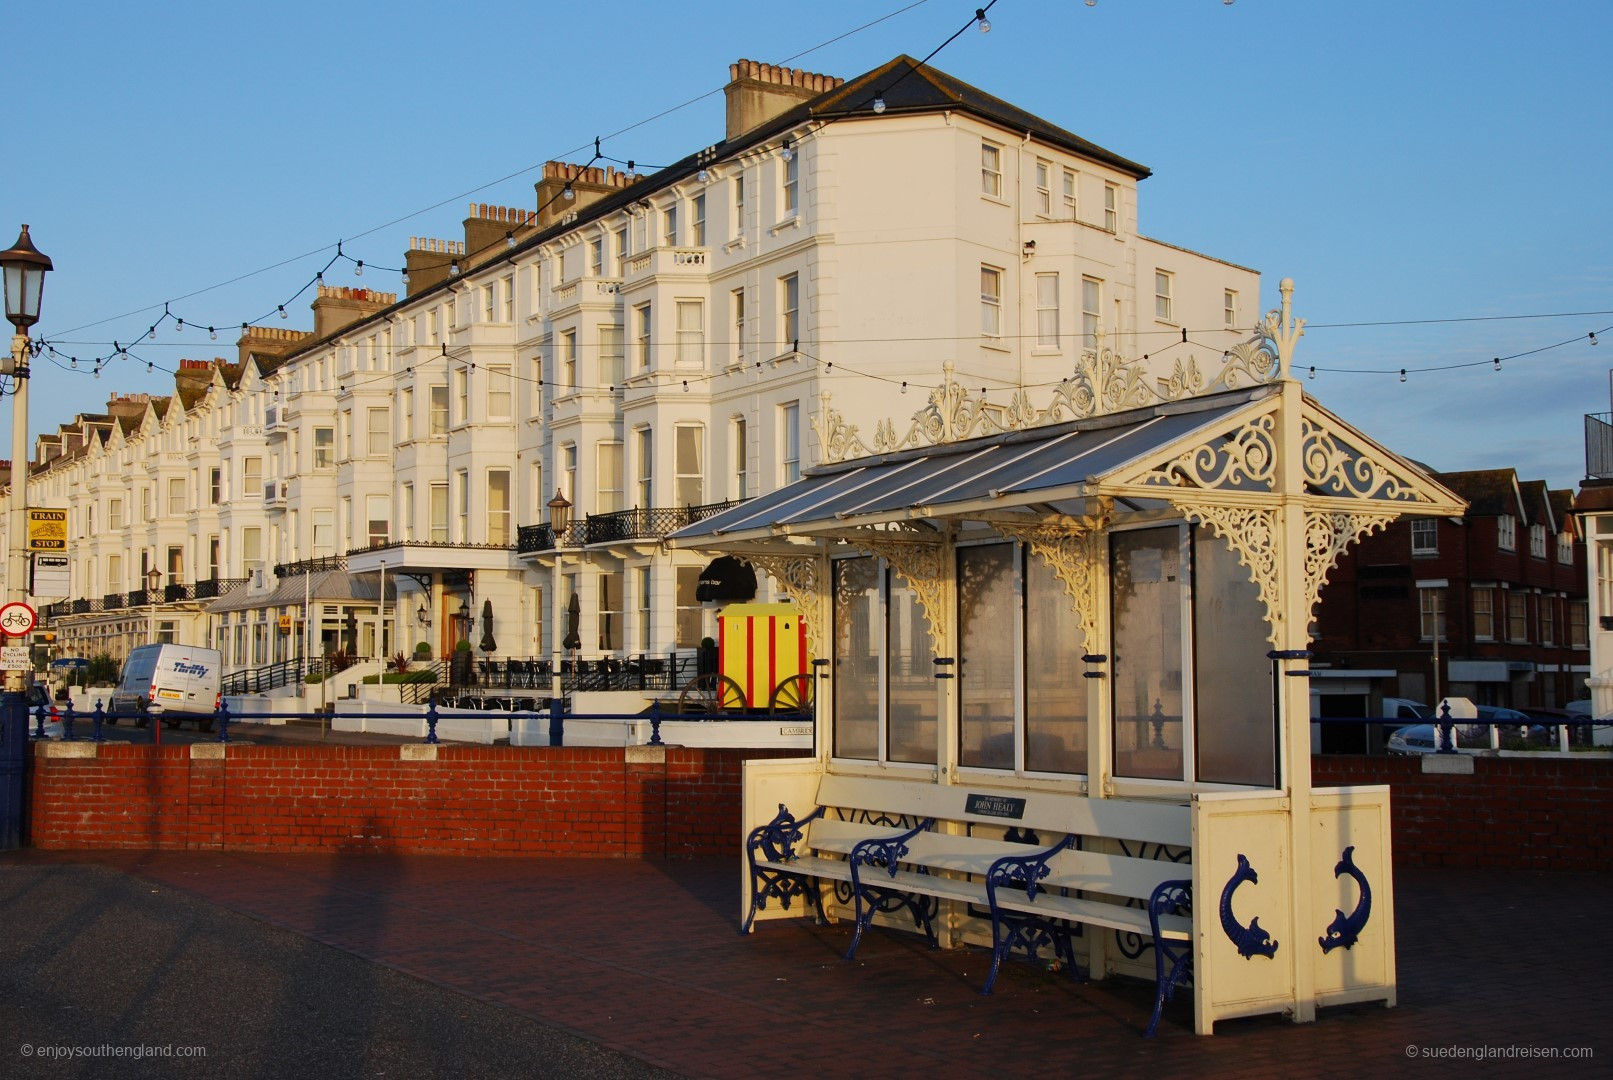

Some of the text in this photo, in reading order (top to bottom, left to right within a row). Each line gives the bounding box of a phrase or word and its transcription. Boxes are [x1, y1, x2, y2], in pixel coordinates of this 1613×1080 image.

[32, 512, 64, 520] TRAIN
[35, 540, 60, 548] STOP
[281, 618, 290, 626] AA
[173, 662, 209, 678] Thrifty
[975, 800, 1015, 812] JOHN HEALY
